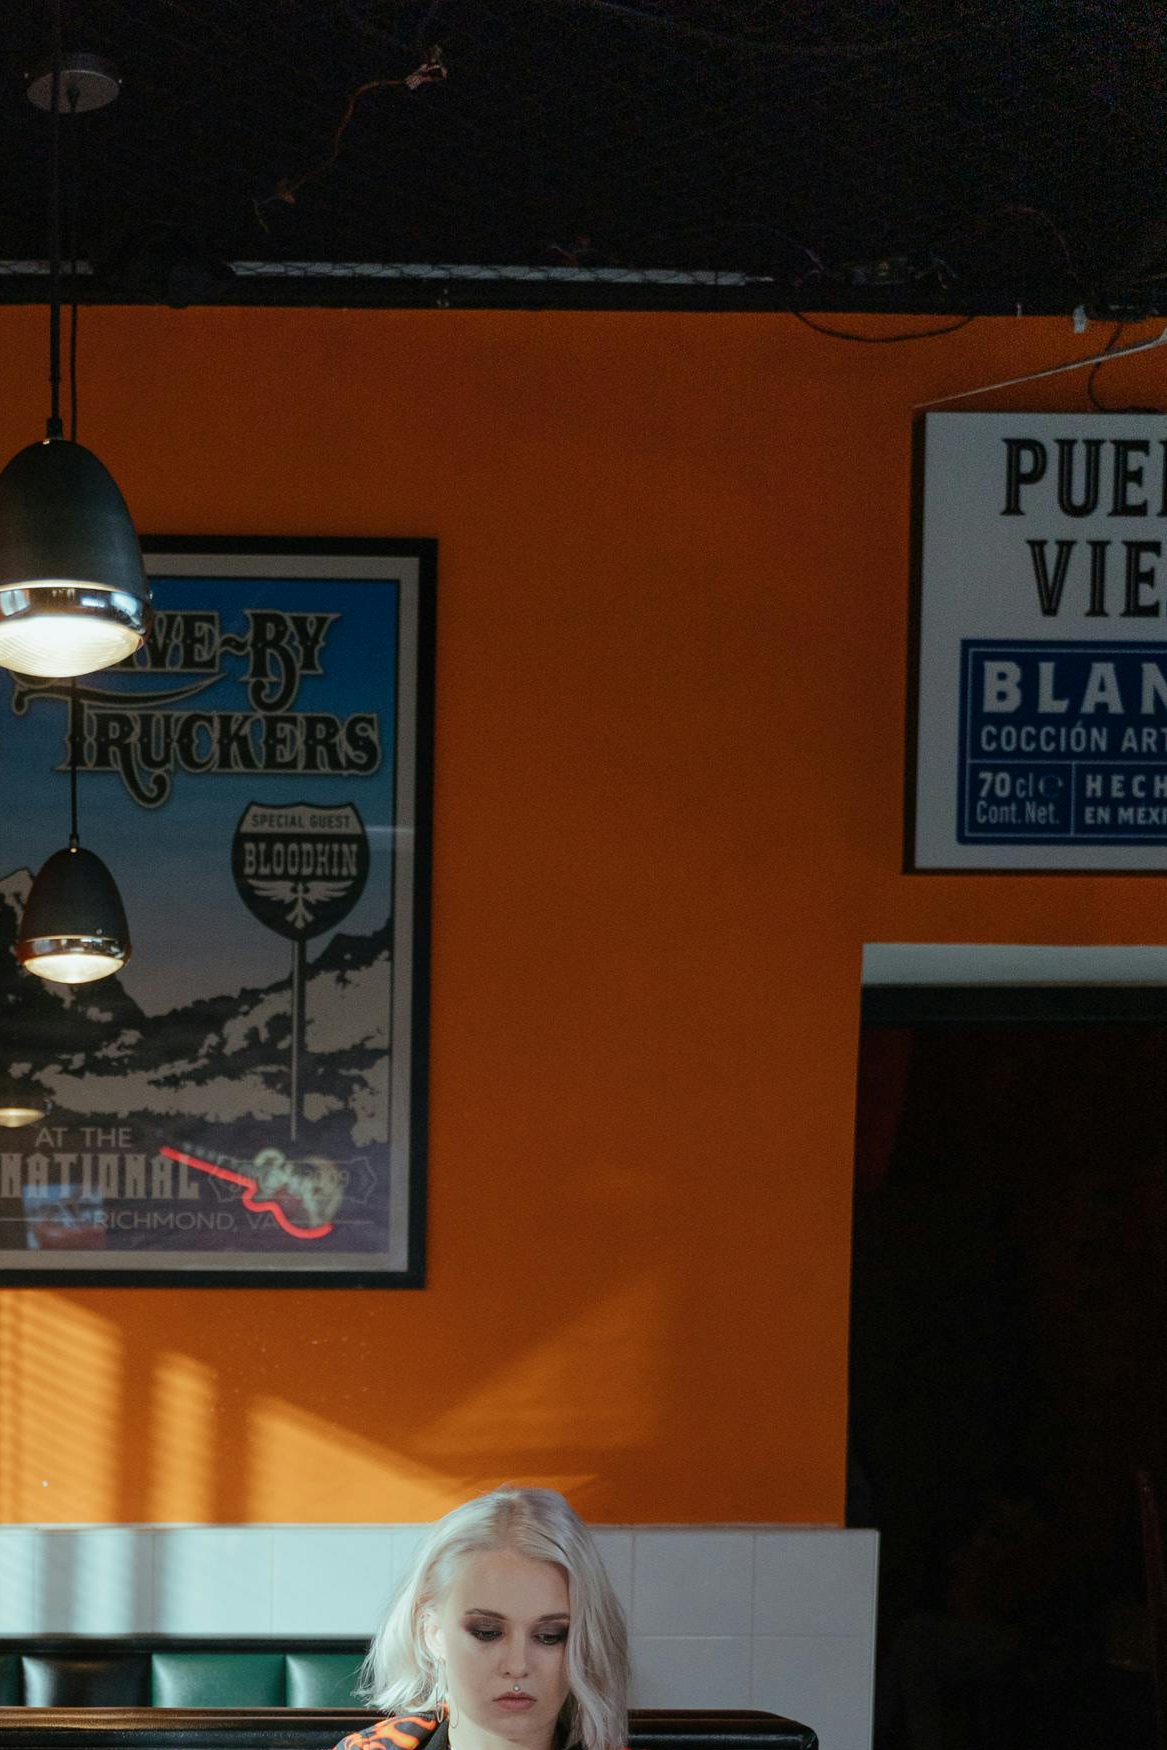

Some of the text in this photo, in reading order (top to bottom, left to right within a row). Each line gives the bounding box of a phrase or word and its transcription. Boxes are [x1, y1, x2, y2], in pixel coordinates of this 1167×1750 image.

[1000, 438, 1167, 518] PUE
[1026, 539, 1167, 618] VIE
[982, 660, 1167, 715] BLAN
[980, 719, 1109, 753] COCCIÓN
[53, 700, 382, 807] TRUCKERS
[1084, 773, 1167, 799] HECH
[251, 813, 351, 829] SPECIAL GUEST
[1084, 806, 1112, 825] EN
[242, 841, 359, 878] BLOODKIN
[34, 1126, 133, 1149] AT THE
[93, 1210, 238, 1232] RICHMOND,
